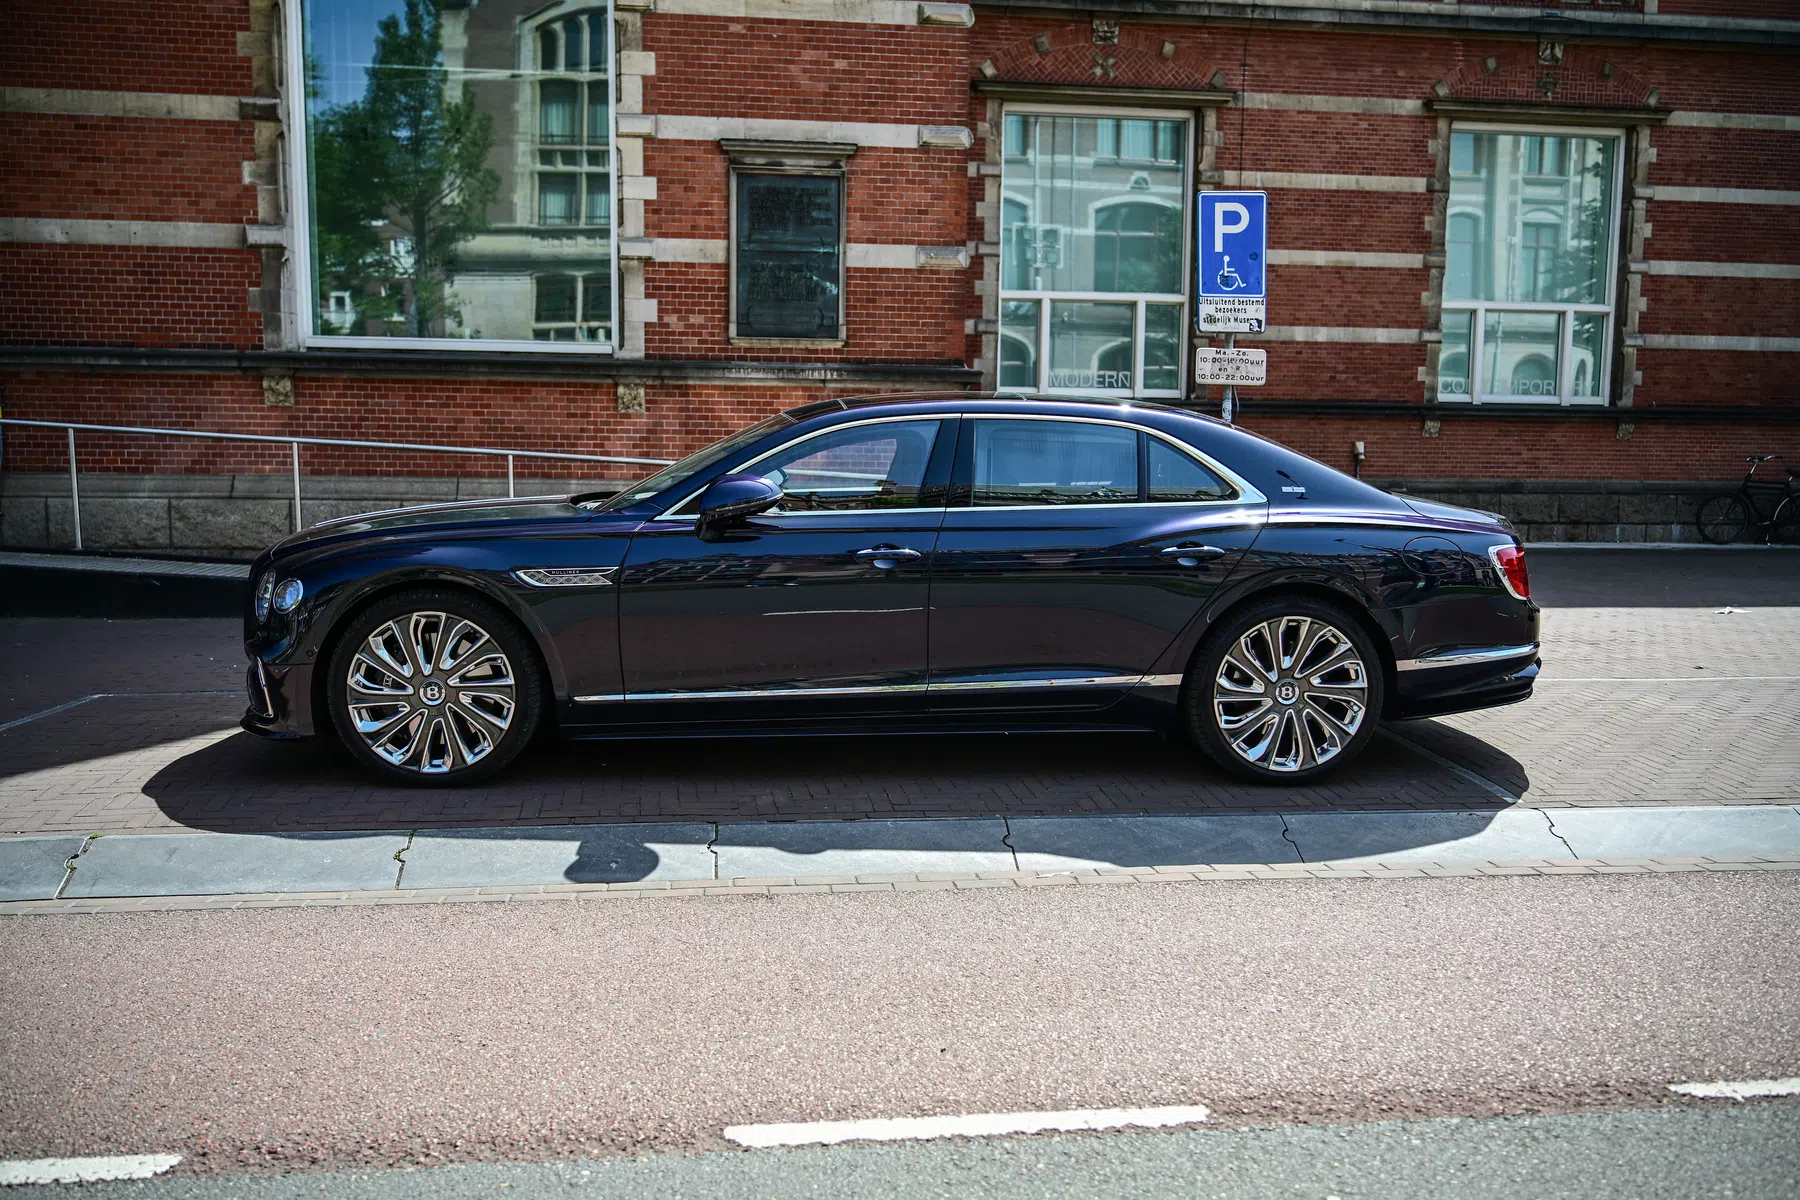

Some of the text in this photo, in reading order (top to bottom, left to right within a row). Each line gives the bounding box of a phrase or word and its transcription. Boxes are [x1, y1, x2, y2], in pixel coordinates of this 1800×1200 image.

[1214, 202, 1250, 253] P
[1199, 298, 1265, 306] Uitsluitend bestemd
[1215, 306, 1247, 314] bezoekers
[1234, 316, 1259, 324] Muse
[1048, 371, 1132, 388] MODERN
[1439, 379, 1596, 397] COEMPORRY
